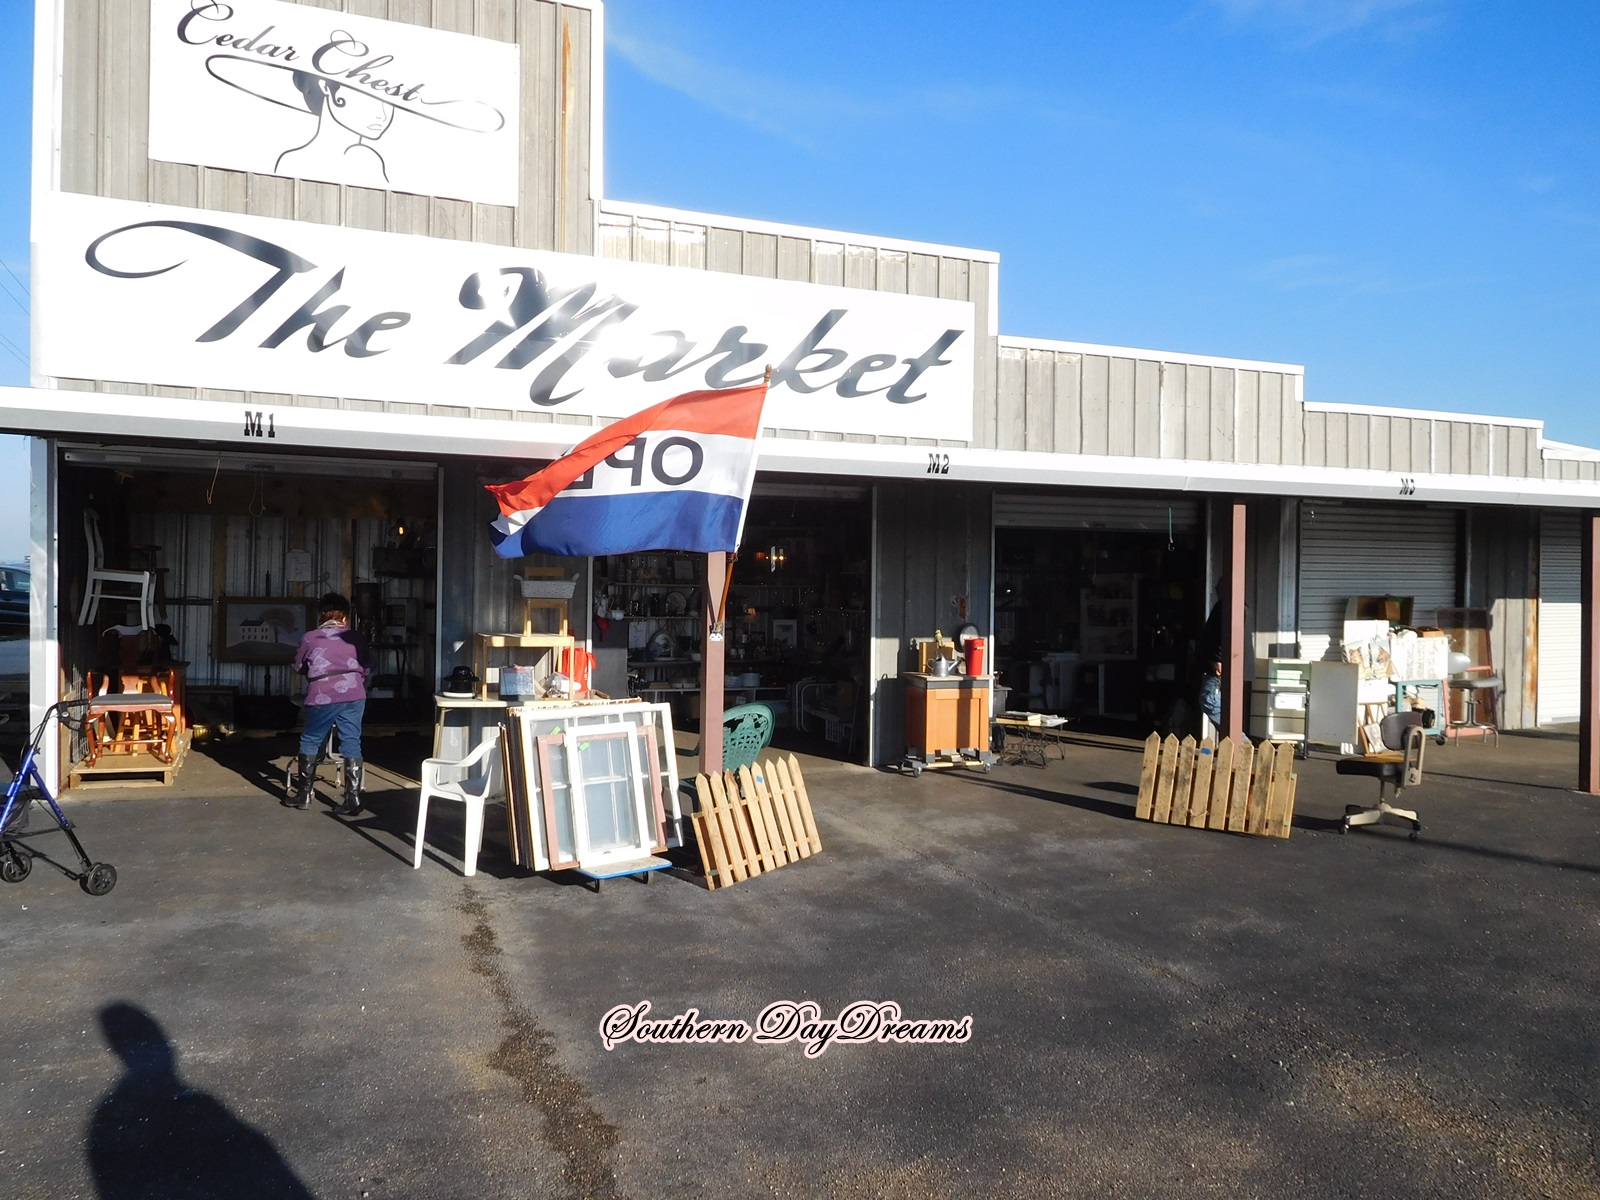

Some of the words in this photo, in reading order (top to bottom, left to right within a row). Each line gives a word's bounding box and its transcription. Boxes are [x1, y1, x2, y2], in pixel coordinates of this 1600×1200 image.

[177, 0, 299, 61] Cedar
[312, 30, 425, 101] Chest
[85, 220, 411, 360] The
[443, 266, 965, 406] Market
[244, 411, 275, 438] M1
[927, 453, 949, 474] M2
